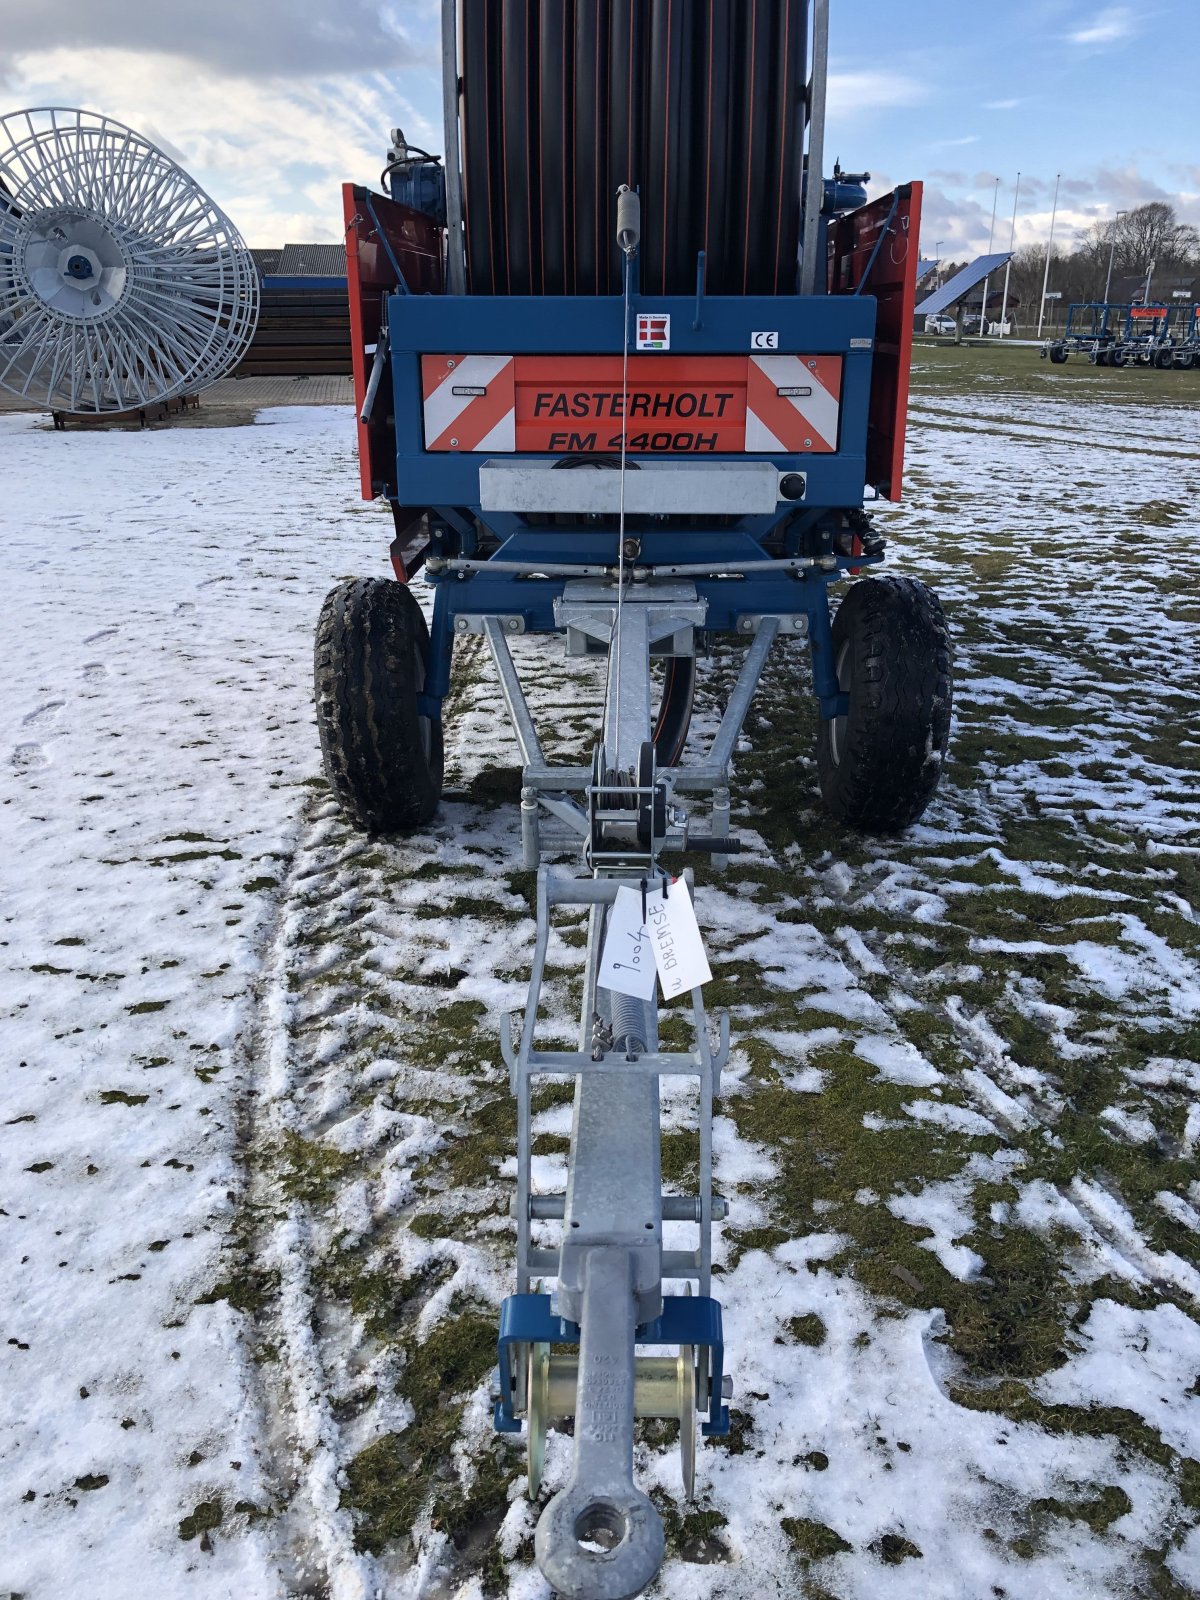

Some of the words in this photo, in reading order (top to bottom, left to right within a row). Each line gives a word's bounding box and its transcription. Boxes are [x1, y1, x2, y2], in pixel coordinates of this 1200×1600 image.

[755, 333, 774, 347] CE
[533, 393, 734, 418] FASTERHOLT
[548, 432, 598, 450] FM
[607, 432, 719, 450] 4400H
[612, 925, 651, 973] 9004
[648, 903, 678, 971] BREMSE
